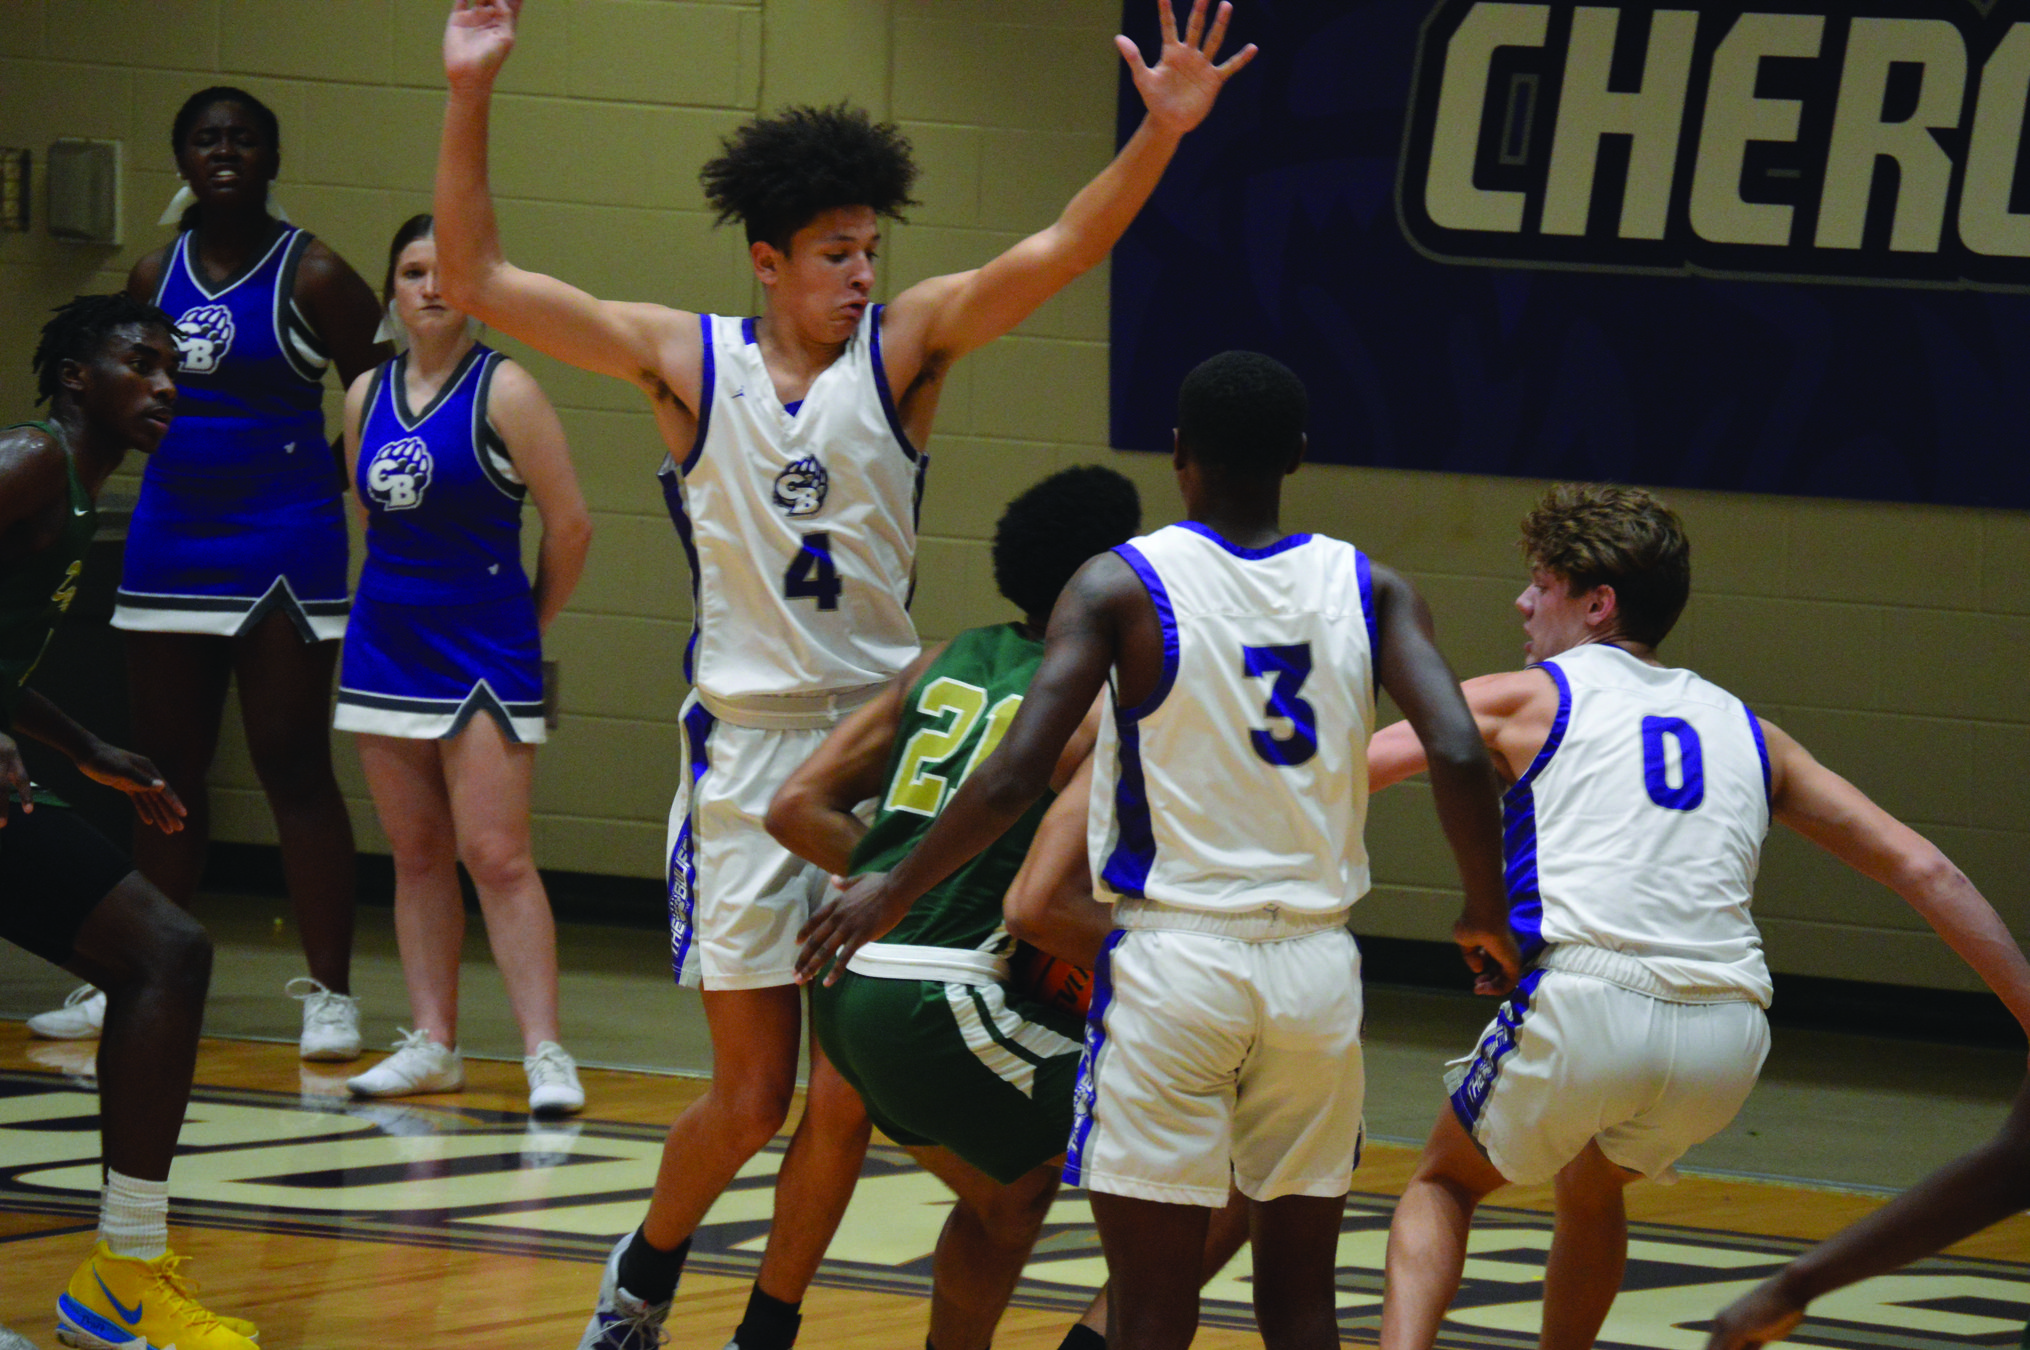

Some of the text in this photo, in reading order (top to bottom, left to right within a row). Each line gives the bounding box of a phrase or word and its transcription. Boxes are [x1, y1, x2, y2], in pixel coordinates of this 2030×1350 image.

[784, 530, 843, 611] 4
[1240, 640, 1318, 768] 3
[1640, 712, 1706, 813] 0
[670, 918, 686, 957] THE
